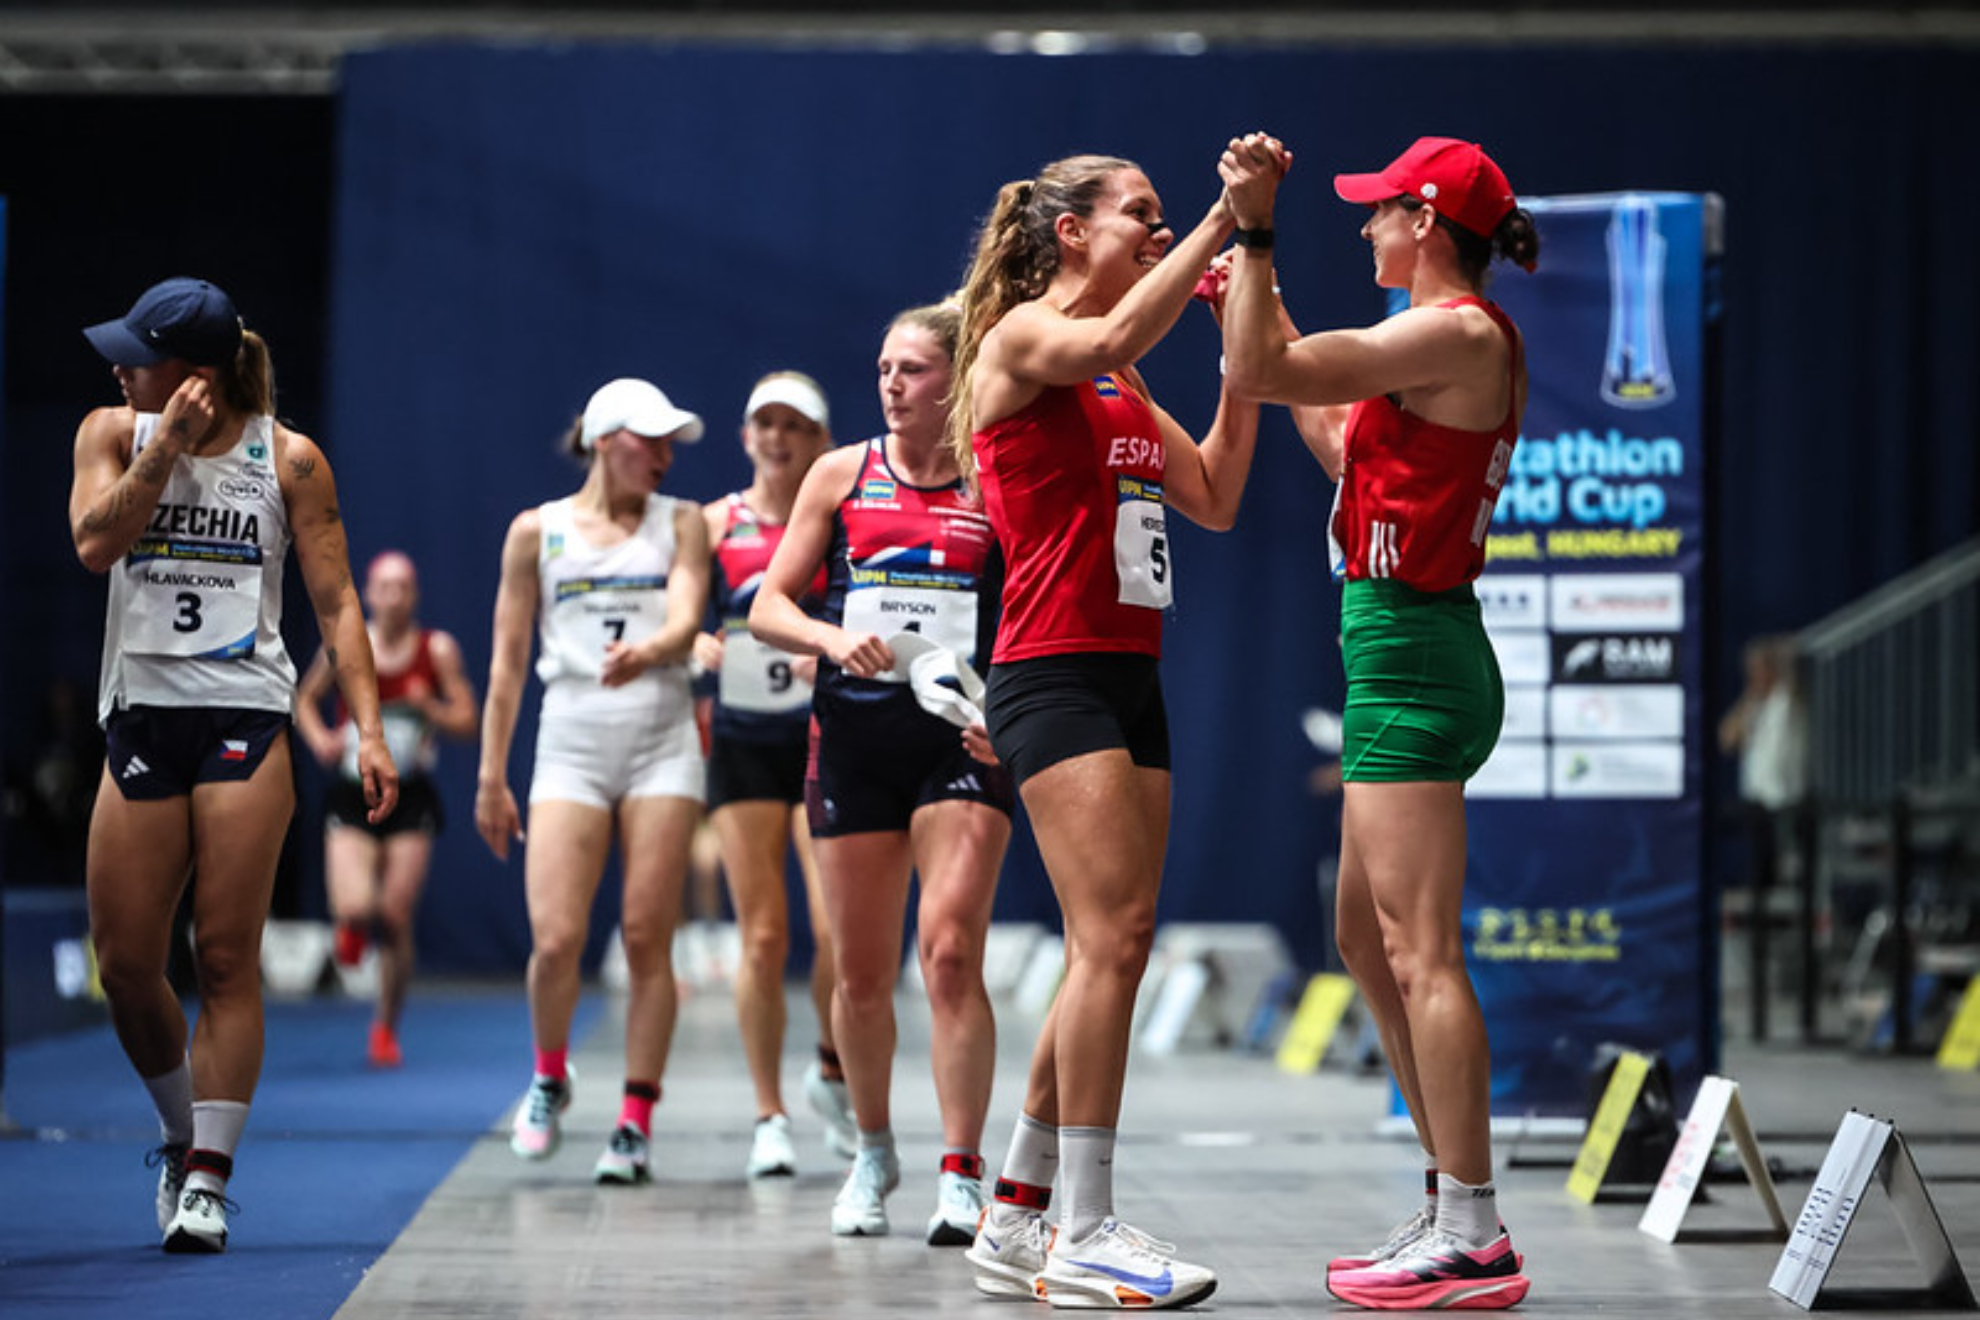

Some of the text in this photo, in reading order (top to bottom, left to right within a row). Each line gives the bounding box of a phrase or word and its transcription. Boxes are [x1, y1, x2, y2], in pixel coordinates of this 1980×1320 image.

[1567, 477, 1665, 531] Cup
[146, 504, 258, 545] ZECHIA
[1150, 537, 1167, 584] 5
[144, 571, 236, 590] HLAVACKOVA
[172, 591, 203, 634] 3
[880, 601, 936, 615] BRYSON
[603, 619, 626, 642] 7
[767, 660, 793, 694] 9
